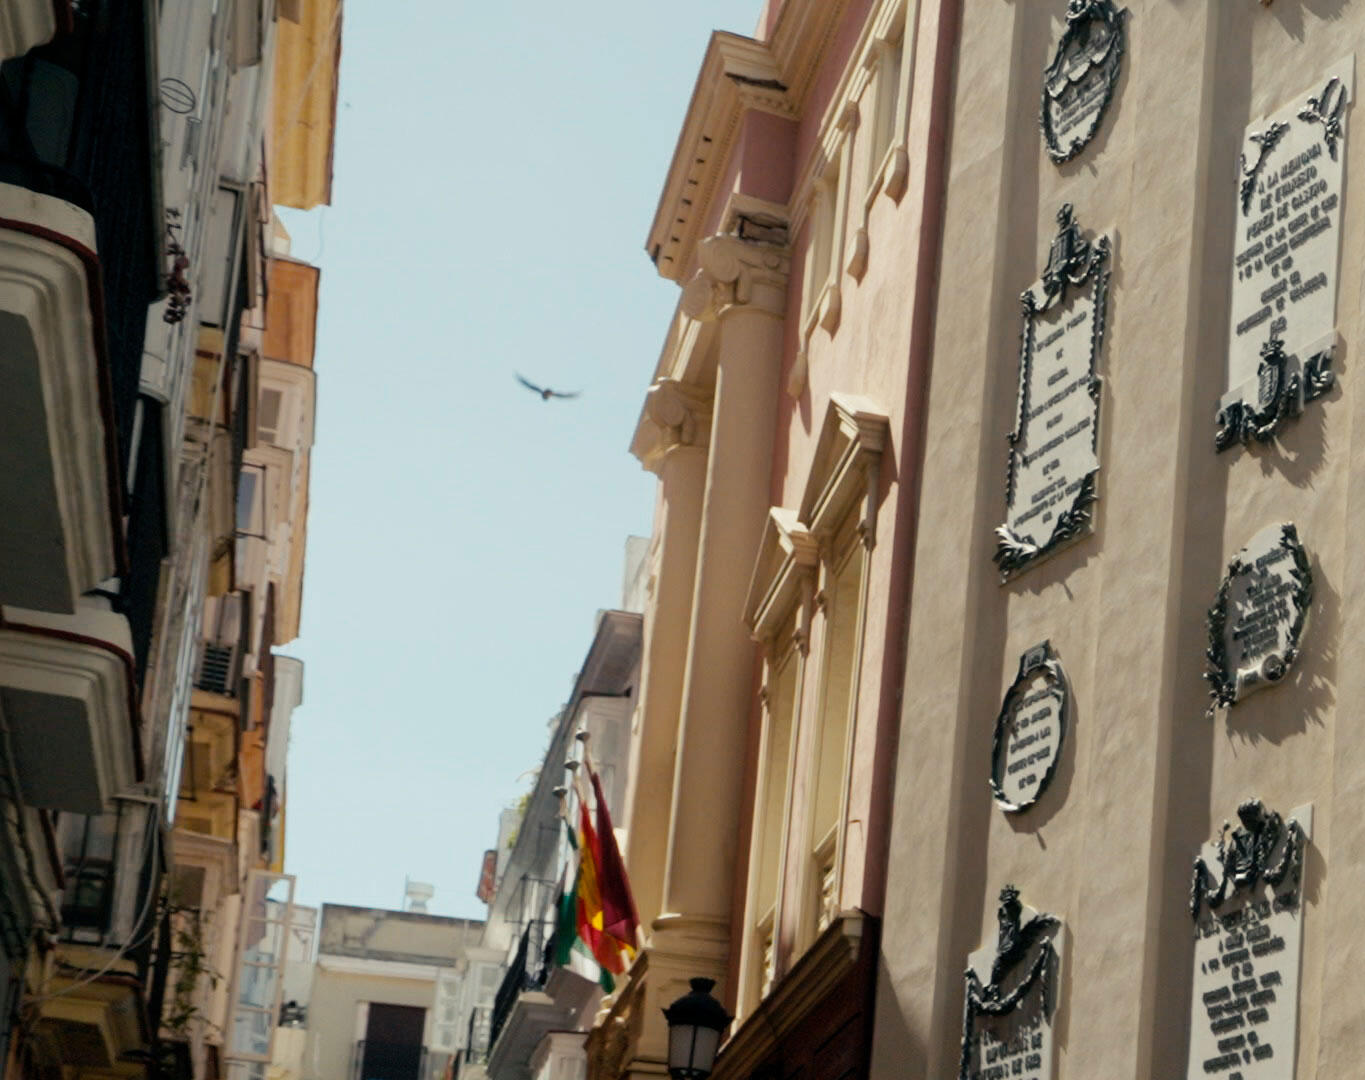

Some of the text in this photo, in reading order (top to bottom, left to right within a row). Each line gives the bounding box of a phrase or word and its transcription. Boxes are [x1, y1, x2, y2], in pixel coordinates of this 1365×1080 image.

[1267, 171, 1279, 190] LA
[1280, 143, 1322, 180] MEMORIA
[1247, 211, 1275, 243] PEREZ
[1277, 201, 1289, 222] DE
[1260, 193, 1272, 214] DE
